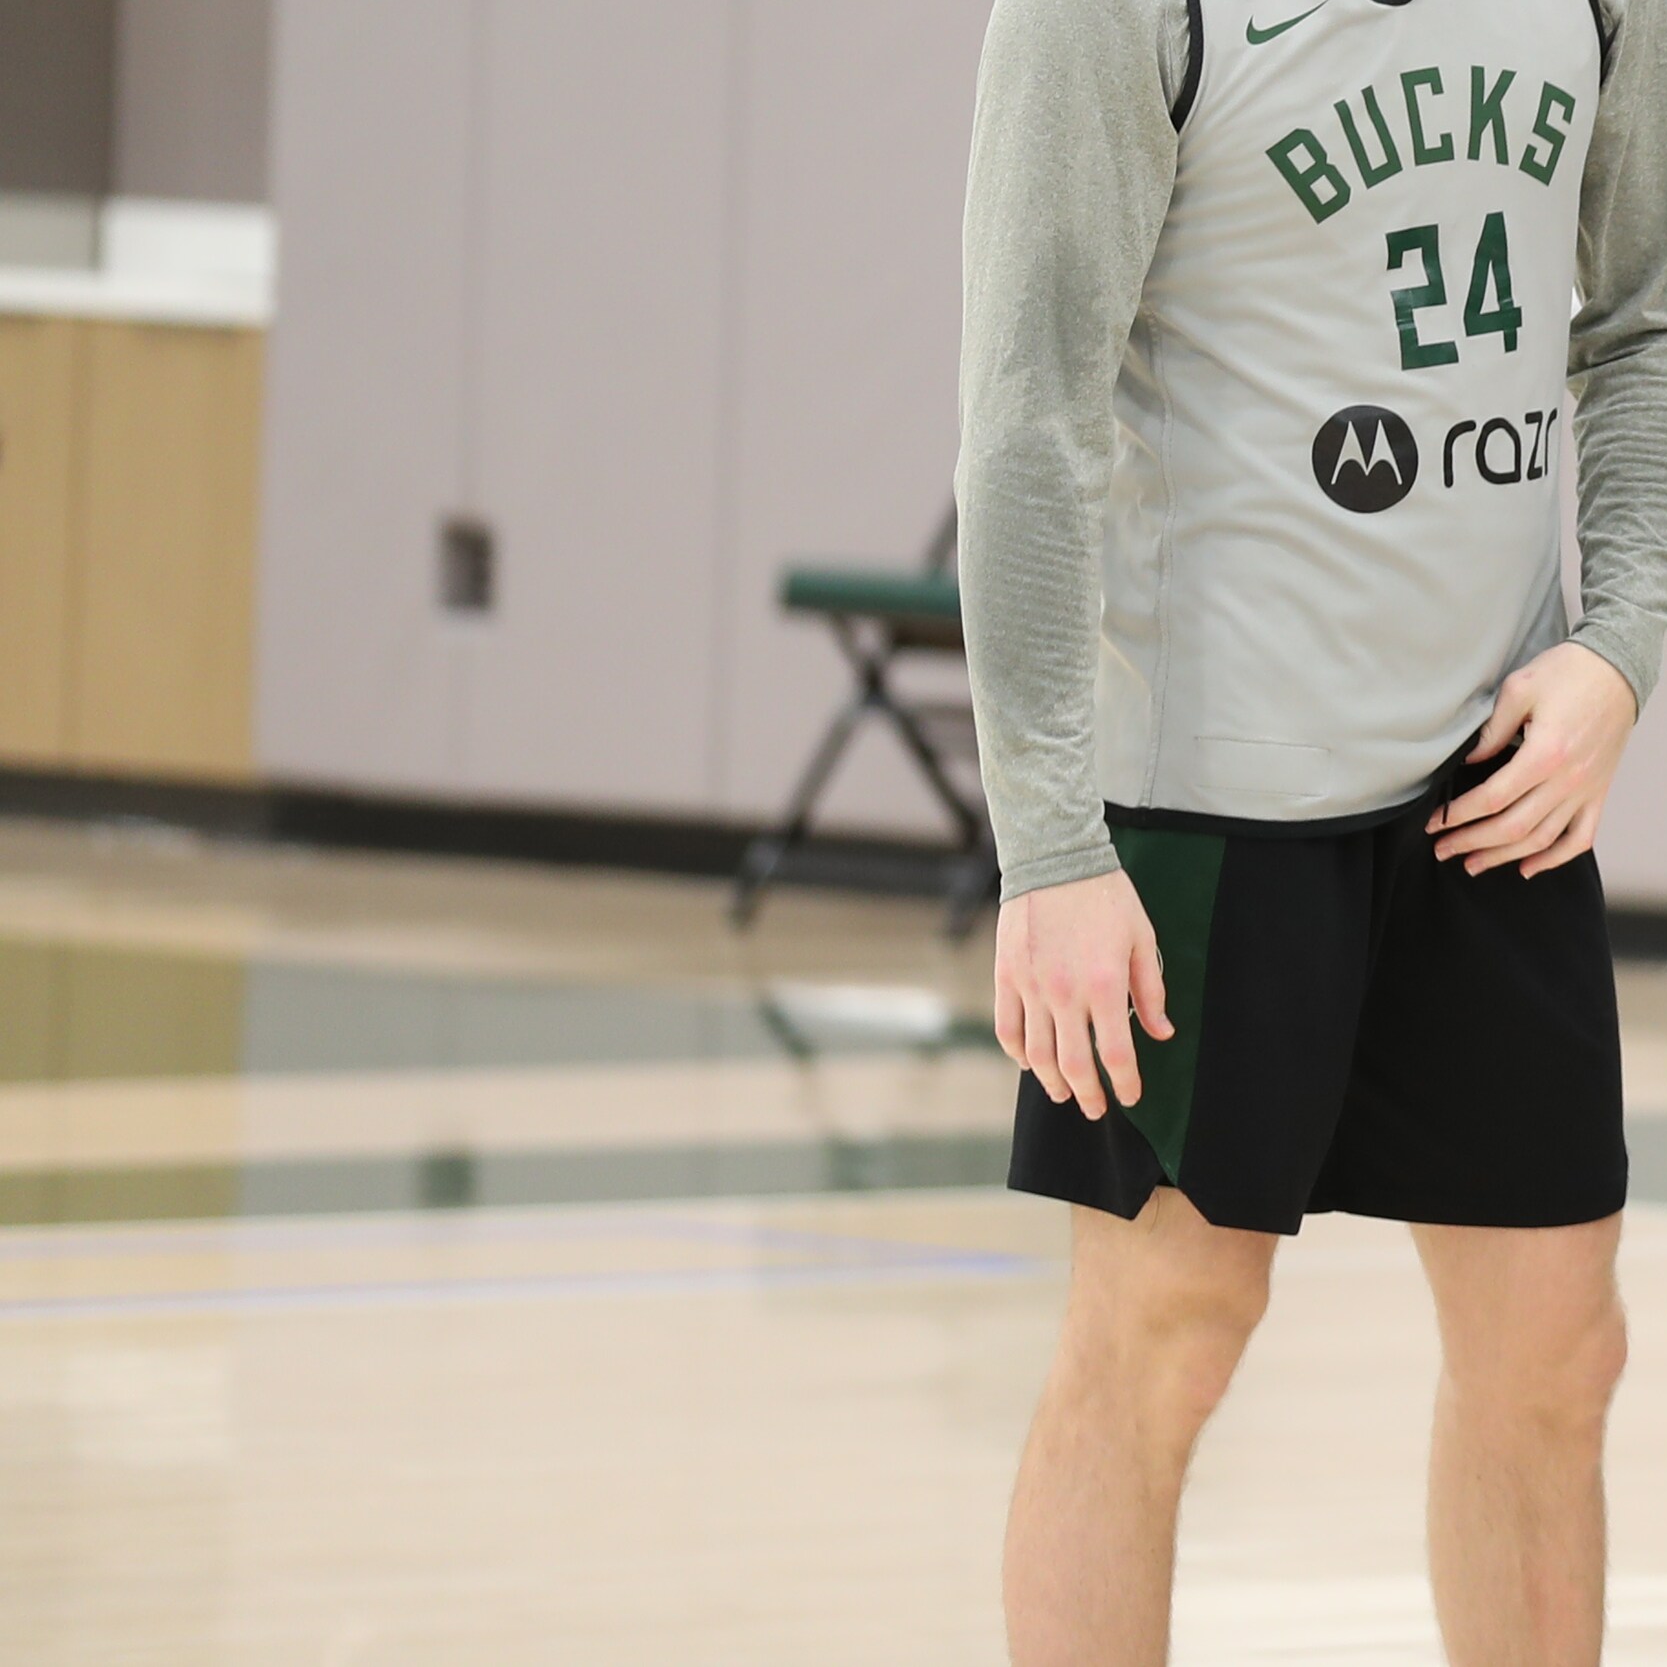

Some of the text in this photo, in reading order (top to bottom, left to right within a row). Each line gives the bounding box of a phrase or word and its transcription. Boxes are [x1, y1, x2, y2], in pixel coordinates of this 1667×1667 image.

[1266, 65, 1576, 223] BUCKS
[1386, 211, 1522, 371] 24
[1443, 407, 1558, 489] razr
